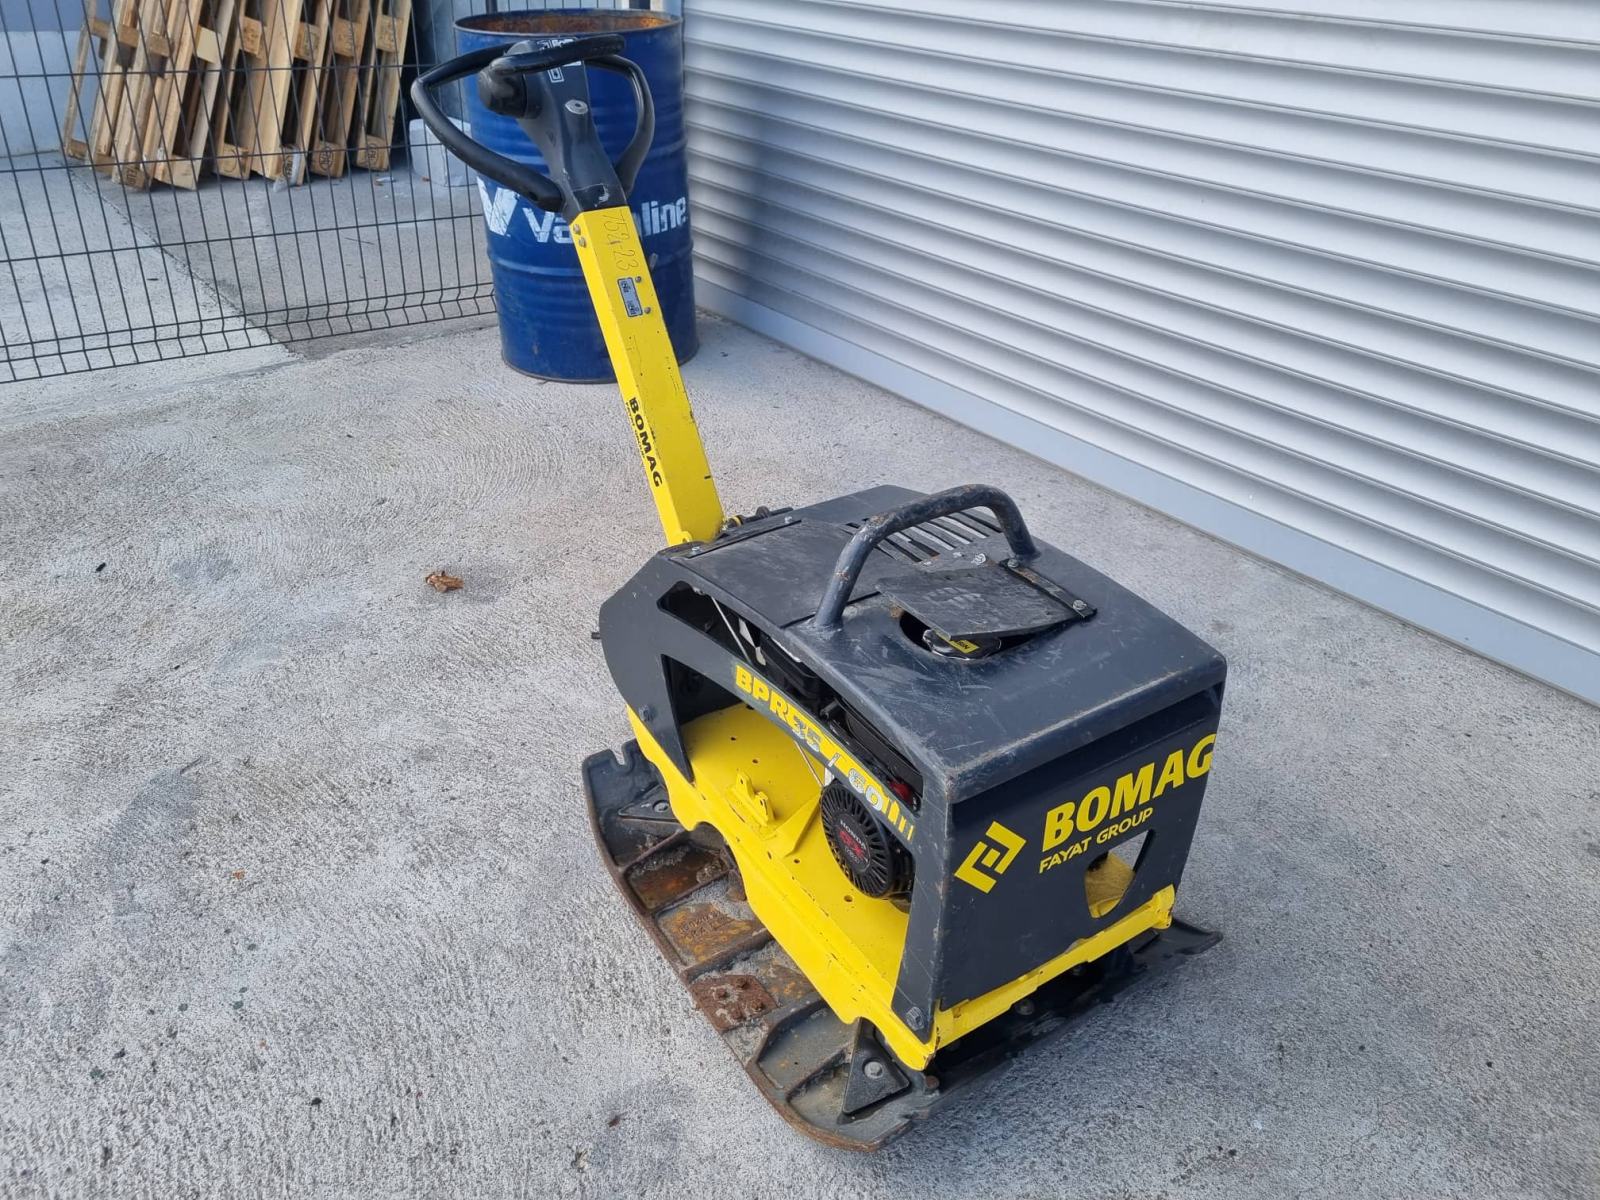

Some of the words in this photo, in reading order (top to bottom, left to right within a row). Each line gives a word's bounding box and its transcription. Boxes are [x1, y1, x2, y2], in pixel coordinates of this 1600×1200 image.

[629, 397, 662, 487] BOMAG
[1042, 733, 1217, 852] BOMAG
[840, 820, 867, 850] HONDA
[1039, 837, 1092, 874] FAYAT
[1096, 807, 1154, 845] GROUP
